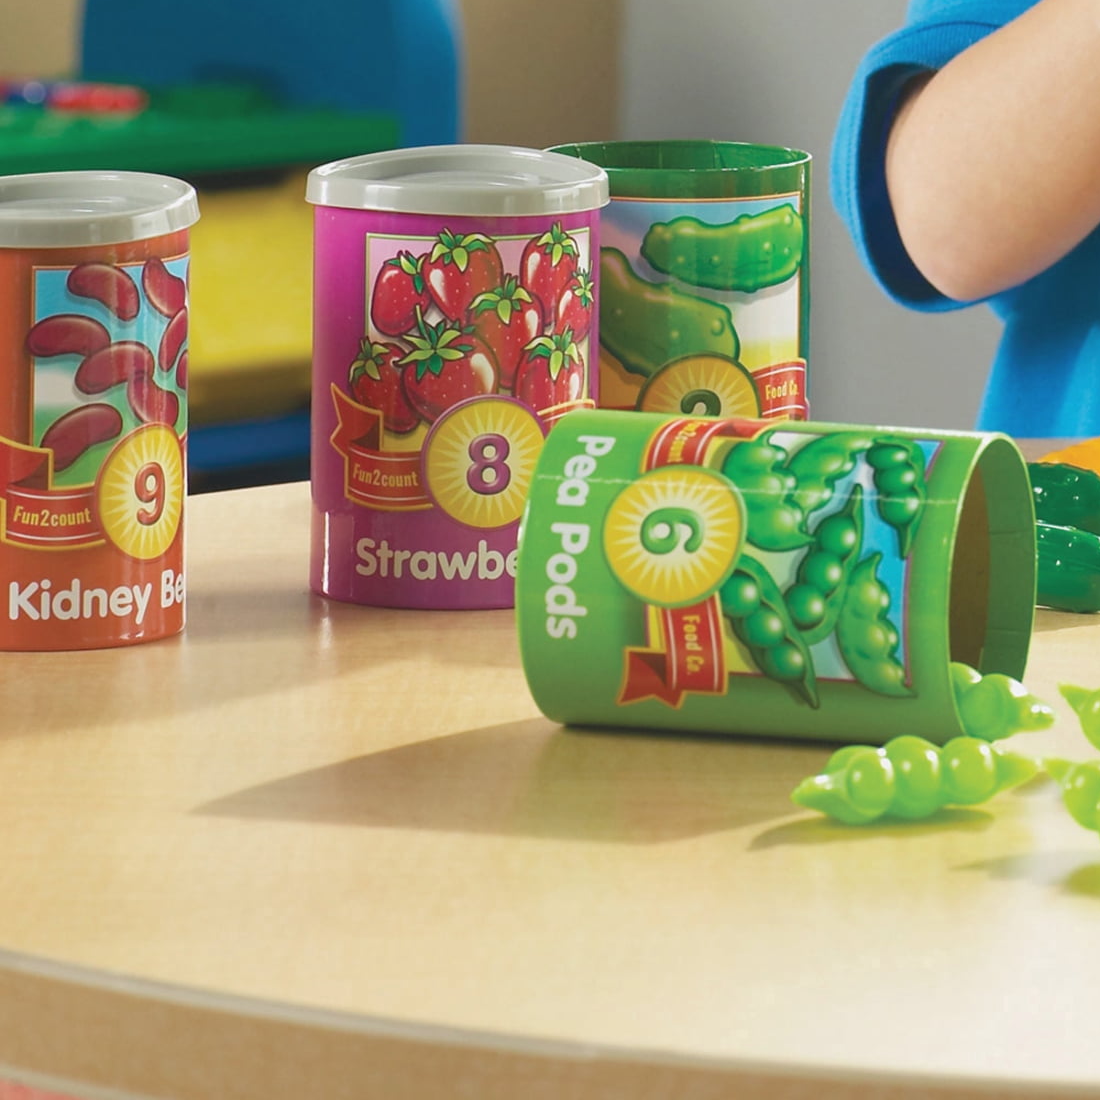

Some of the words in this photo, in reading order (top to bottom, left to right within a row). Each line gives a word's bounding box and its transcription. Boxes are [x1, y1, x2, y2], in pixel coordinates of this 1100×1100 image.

[765, 381, 788, 400] Food
[353, 464, 419, 488] Fun2count
[466, 433, 511, 495] 8
[556, 434, 617, 506] Pea
[12, 505, 92, 527] Fun2count
[134, 461, 167, 527] 9
[640, 506, 705, 556] 6
[9, 578, 153, 625] Kidney
[545, 522, 591, 640] Pods
[682, 614, 703, 652] Food
